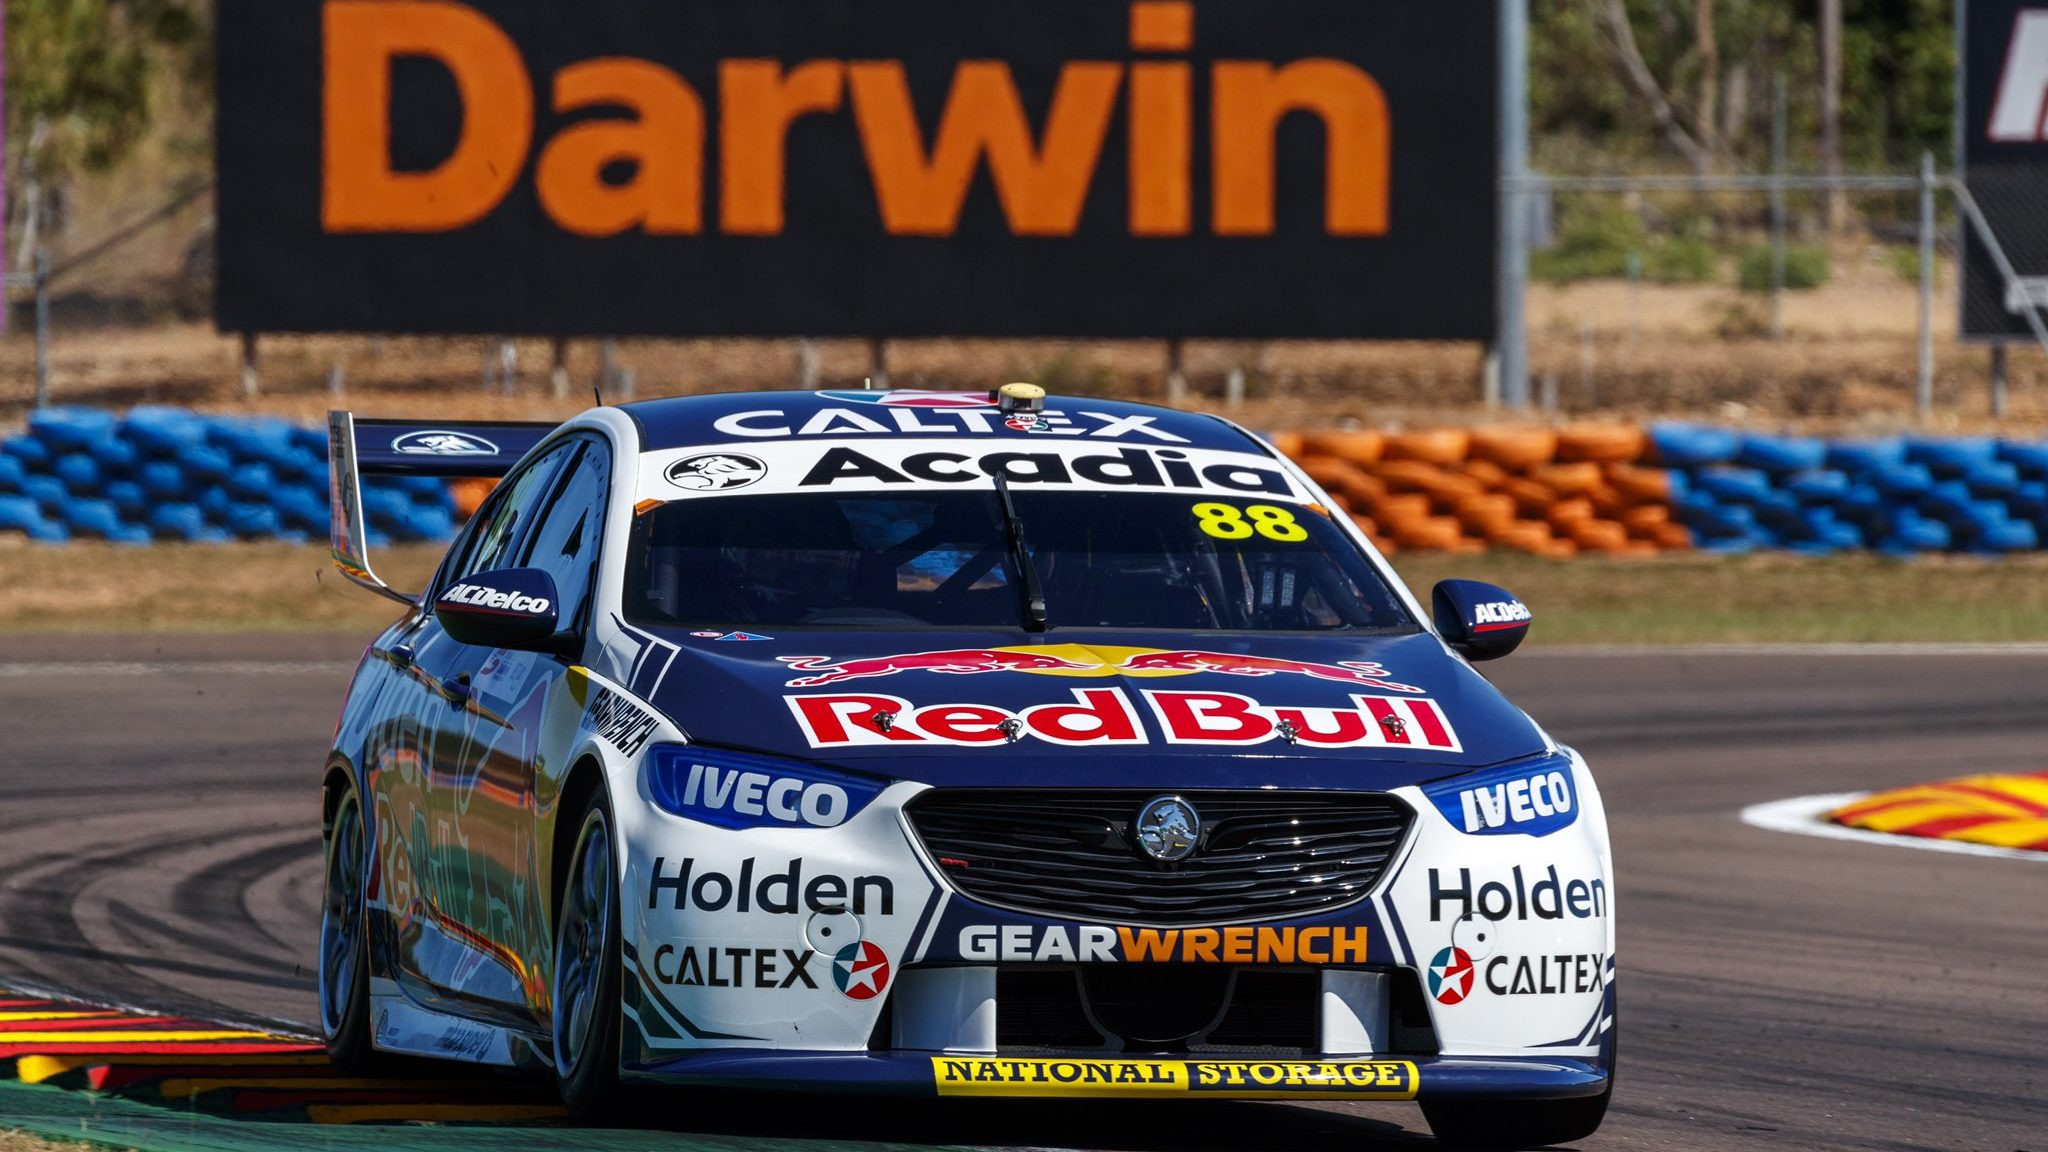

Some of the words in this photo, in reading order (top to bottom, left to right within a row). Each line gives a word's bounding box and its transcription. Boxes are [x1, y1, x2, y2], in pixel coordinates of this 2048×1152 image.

[321, 0, 1391, 236] Darwin
[798, 447, 1295, 498] Acadia
[1192, 502, 1308, 542] 88
[440, 583, 550, 613] ACDelco
[784, 687, 1148, 749] Red
[1140, 689, 1464, 753] Bull
[684, 764, 849, 827] IVECO
[1460, 771, 1571, 833] IVECO
[649, 856, 894, 915] Holden
[1428, 864, 1607, 922] Holden
[654, 943, 819, 989] CALTEX
[958, 924, 1368, 963] GEARWRENCH
[1485, 952, 1605, 995] CALTEX
[943, 1060, 1176, 1084] NATIONAL
[1198, 1062, 1402, 1087] STORAGE
